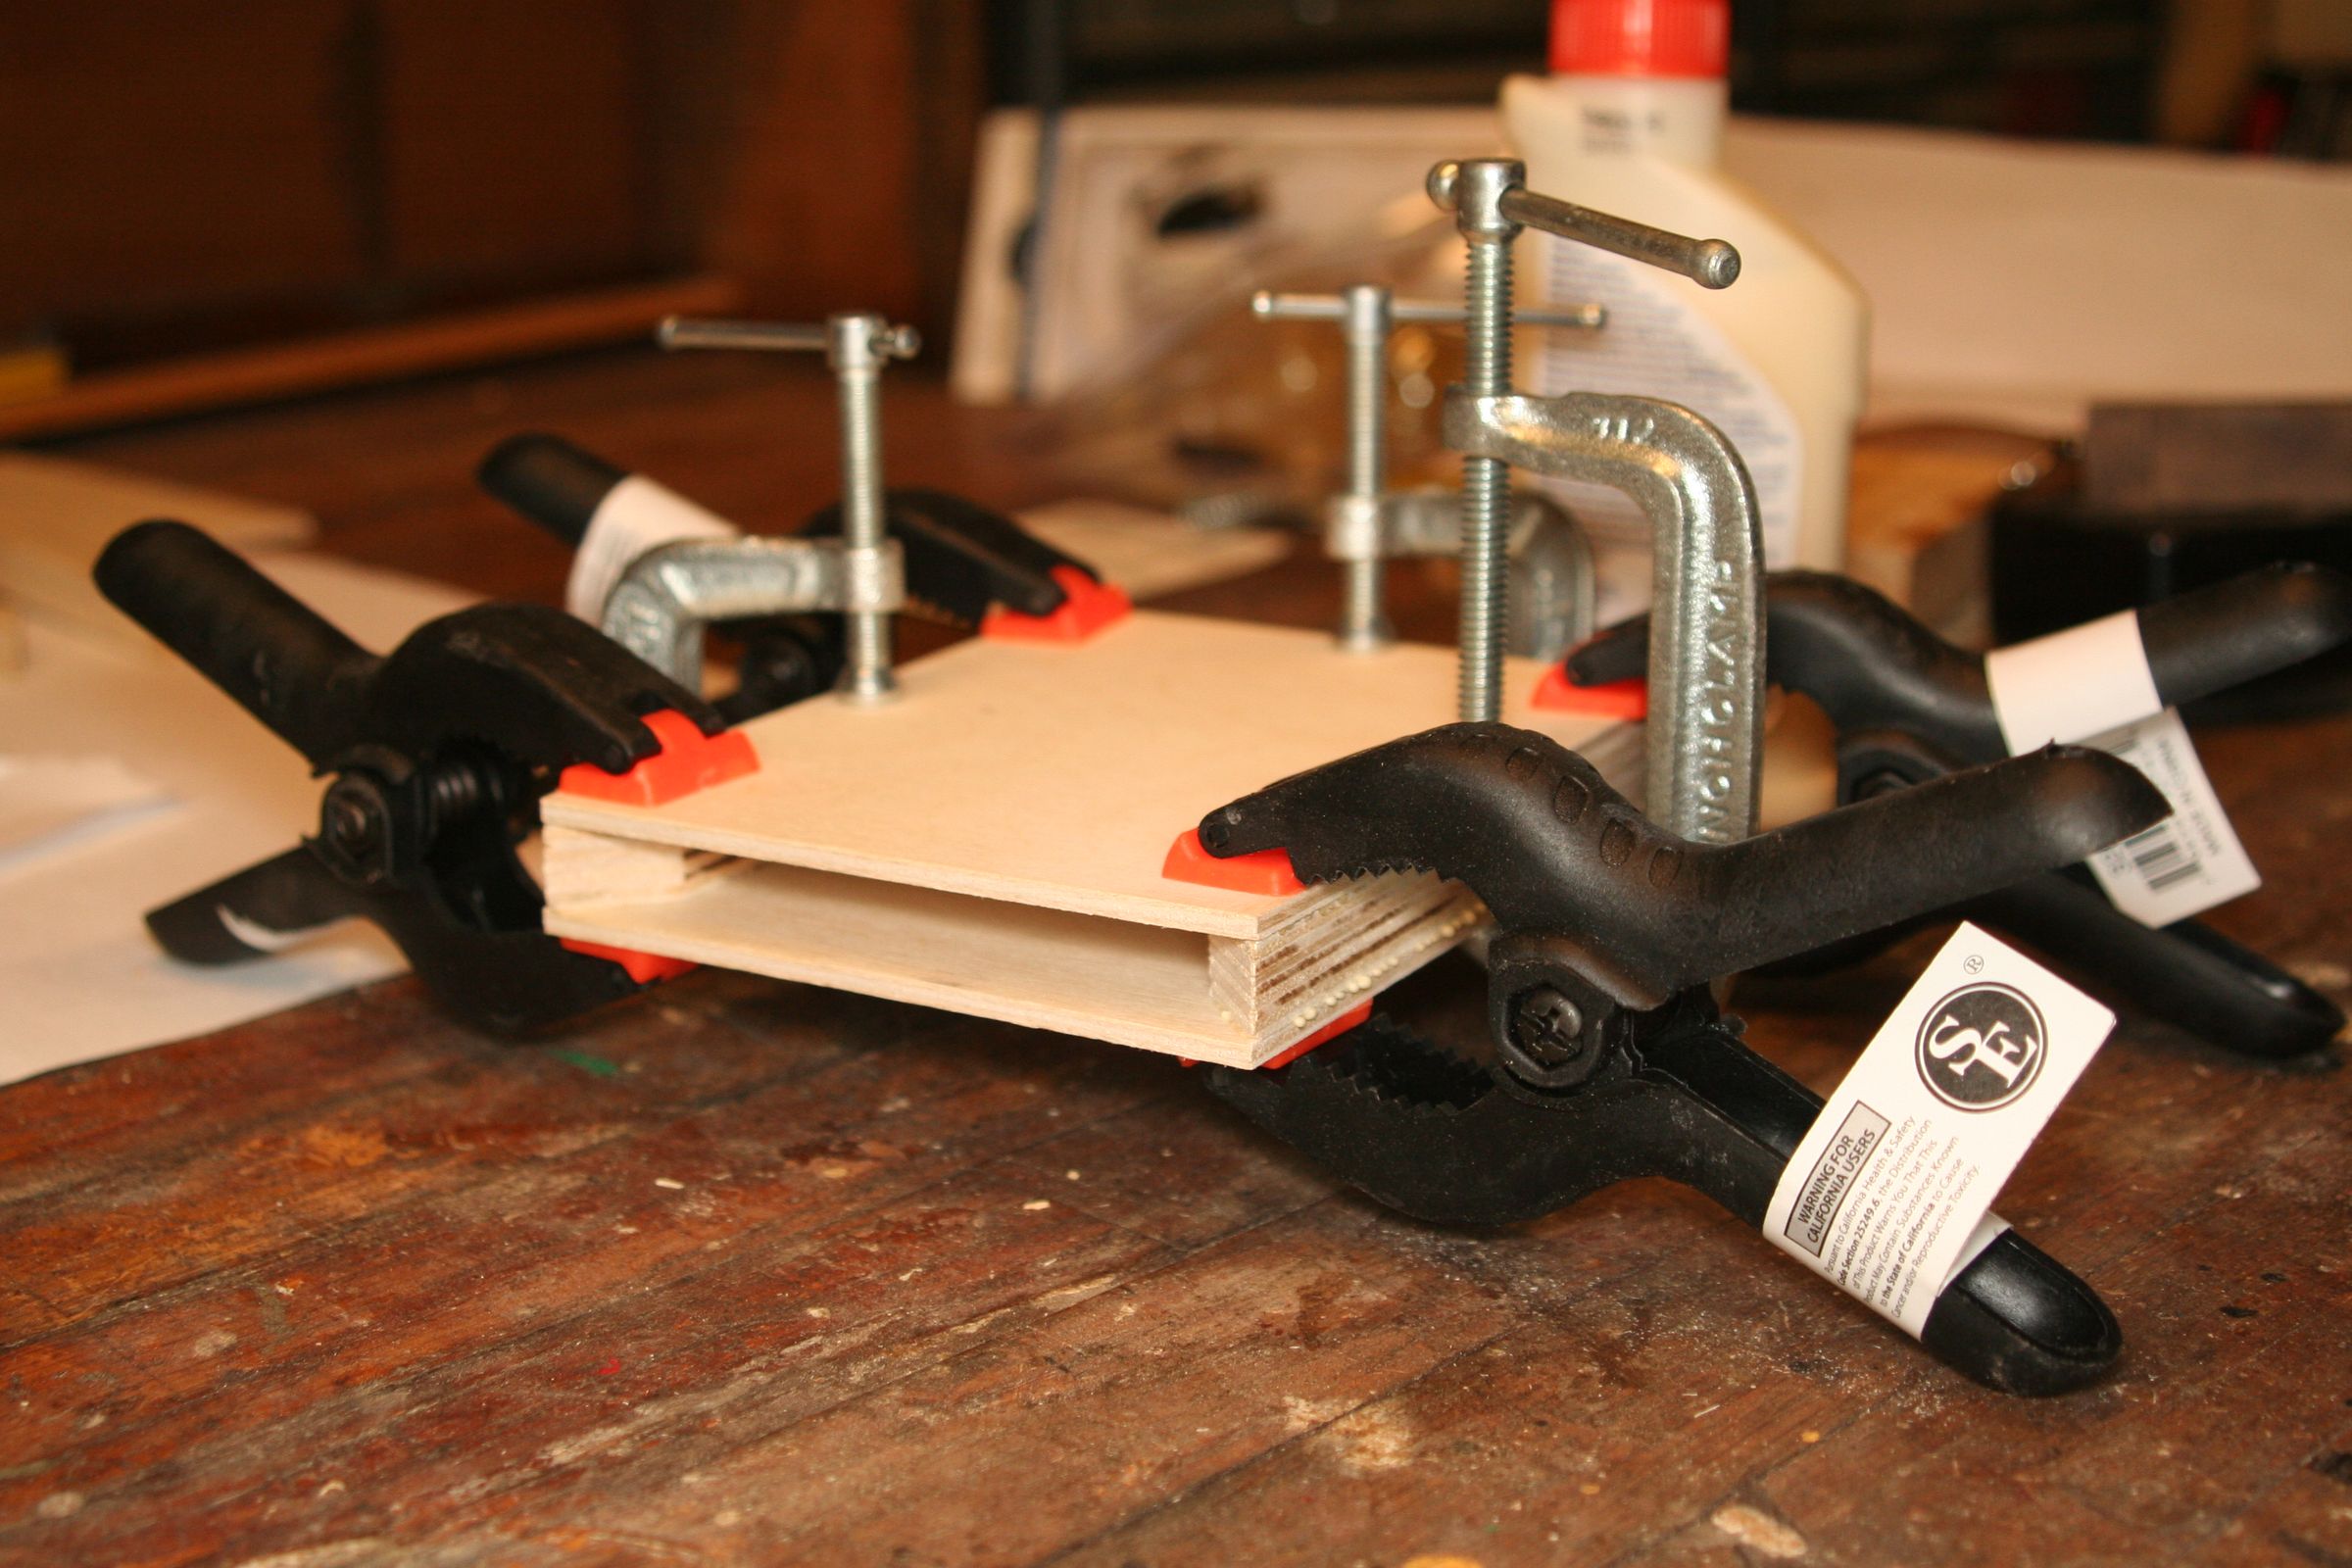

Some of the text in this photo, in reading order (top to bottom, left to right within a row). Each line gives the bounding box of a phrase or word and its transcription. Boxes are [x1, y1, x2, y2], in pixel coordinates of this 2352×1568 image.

[1928, 1014, 2037, 1088] SE
[1889, 1115, 1915, 1149] Safety
[1797, 1135, 1854, 1224] WARNING FOR
[1807, 1129, 1875, 1243] CALIFORNIA USERS
[1841, 1239, 1860, 1270] Section
[1878, 1178, 1893, 1197] the
[1888, 1120, 1932, 1178] Distribution
[1862, 1157, 1887, 1191] Health
[1939, 1158, 1964, 1189] Cause
[1838, 1192, 1867, 1235] California
[1859, 1234, 1880, 1267] Product
[1875, 1204, 1896, 1234] Warns
[1890, 1185, 1909, 1203] You
[1903, 1160, 1924, 1183] That
[1917, 1139, 1937, 1160] This
[1872, 1262, 1886, 1281] May
[1879, 1229, 1901, 1263] Contain
[1896, 1172, 1936, 1229] Substances
[1931, 1137, 1958, 1172] Known
[1932, 1190, 1943, 1201] to
[1835, 1234, 1845, 1245] to
[1902, 1202, 1936, 1252] California
[1912, 1204, 1953, 1268] Reproductive
[1886, 1263, 1902, 1286] State
[1898, 1250, 1906, 1264] of
[1883, 1285, 1893, 1299] the
